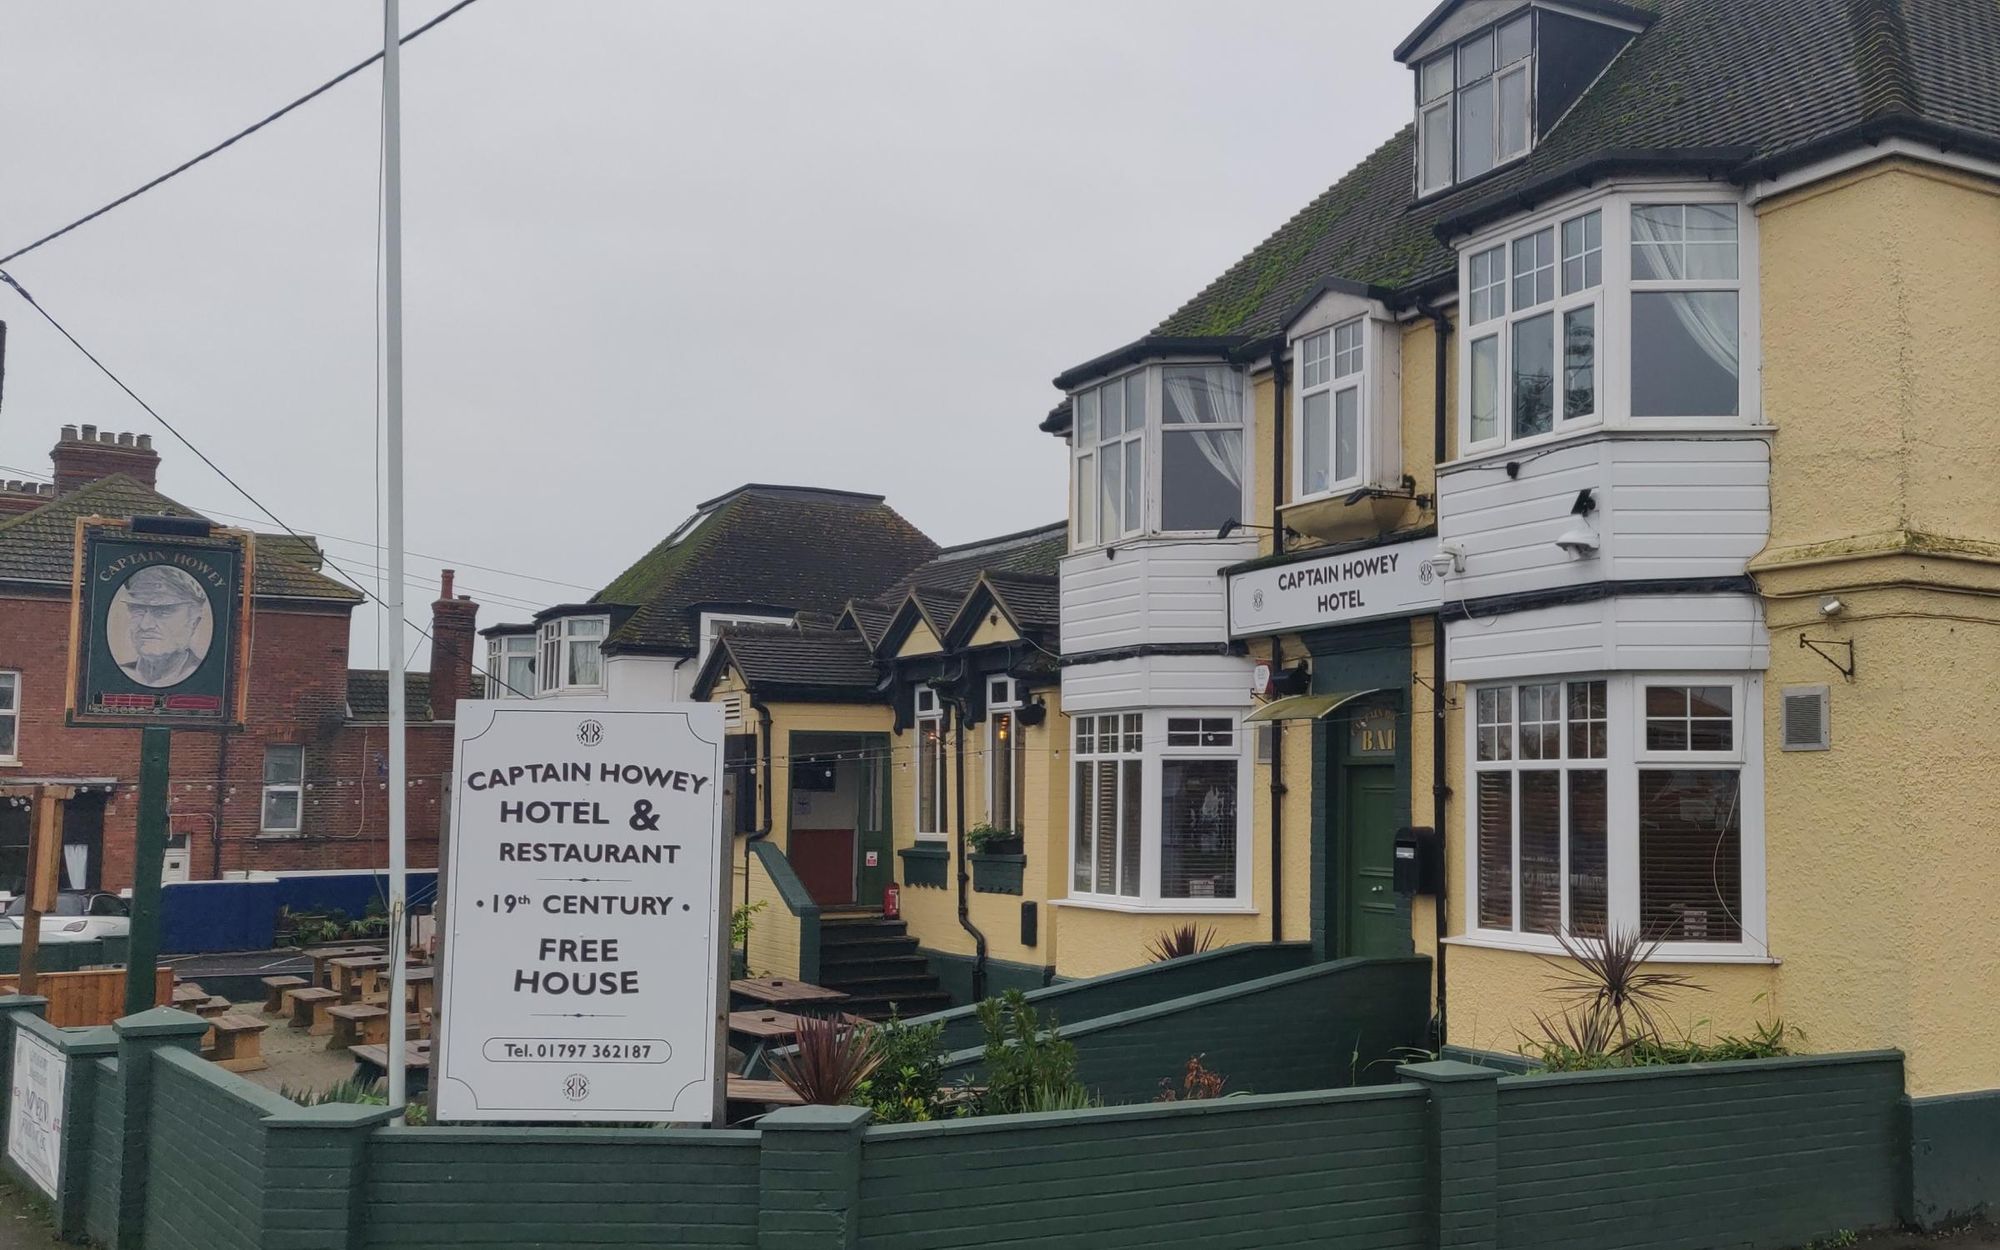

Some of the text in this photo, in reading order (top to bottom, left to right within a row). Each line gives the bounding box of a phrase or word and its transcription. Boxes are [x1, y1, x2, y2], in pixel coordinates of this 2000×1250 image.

[99, 551, 226, 587] CAPTAIN HOWEY
[1278, 564, 1339, 591] CAPTAIN
[1343, 553, 1399, 580] HOWEY
[1317, 589, 1365, 613] HOTEL
[467, 762, 708, 794] CAPTAIN HOWEY
[500, 799, 661, 831] HOTEL &
[499, 842, 681, 864] RESTAURANT
[493, 894, 673, 915] 19th CENTURY
[539, 938, 619, 962] FREE
[513, 969, 639, 995] HOUSE
[504, 1043, 652, 1059] Tel. 01797 362187
